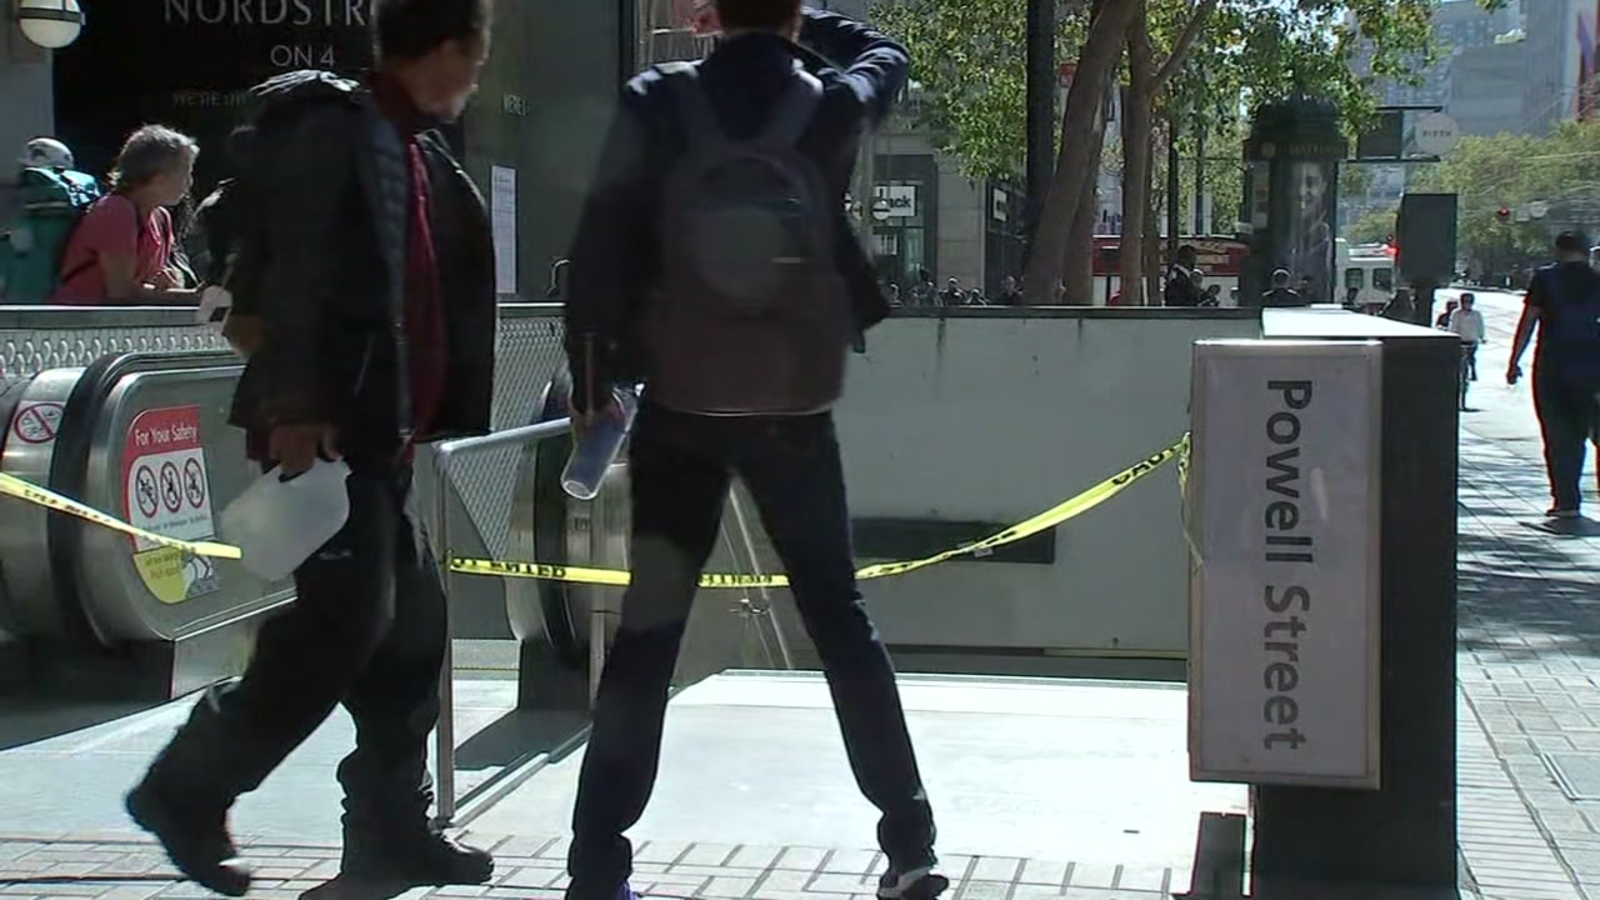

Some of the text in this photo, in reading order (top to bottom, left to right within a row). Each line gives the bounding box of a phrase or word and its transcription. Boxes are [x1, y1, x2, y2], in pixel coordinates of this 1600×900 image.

[164, 0, 375, 26] NORDSTR
[270, 45, 335, 66] ON 4
[134, 421, 197, 446] For Your Safety
[1263, 379, 1314, 751] Powell Street
